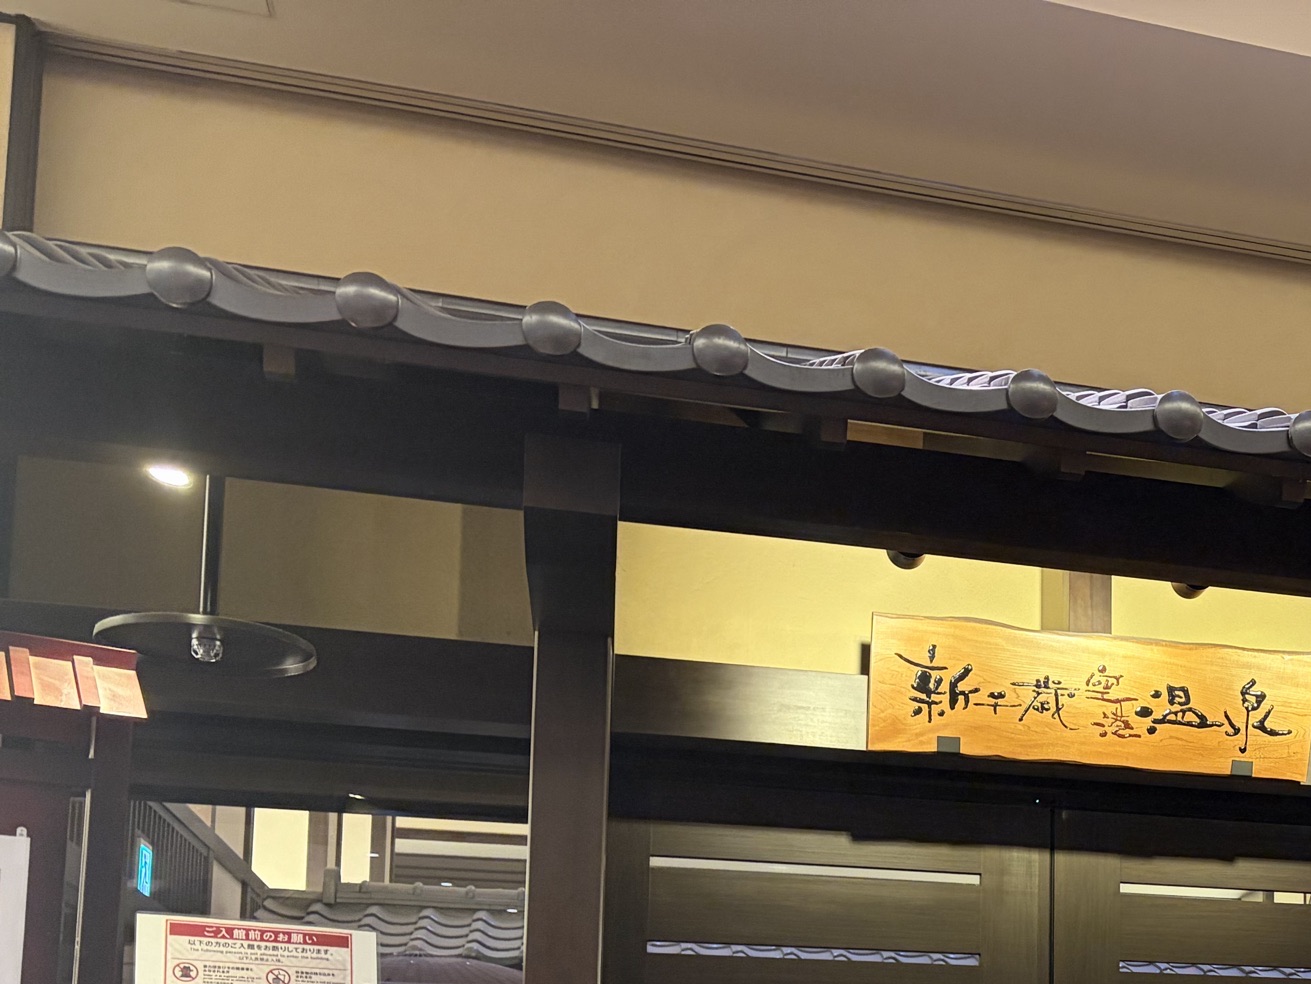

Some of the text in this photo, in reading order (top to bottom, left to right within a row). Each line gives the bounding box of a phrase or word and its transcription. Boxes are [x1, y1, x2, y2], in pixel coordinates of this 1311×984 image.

[895, 644, 1293, 754] 新千歳空港温泉
[204, 927, 317, 945] ご入館前のお願い
